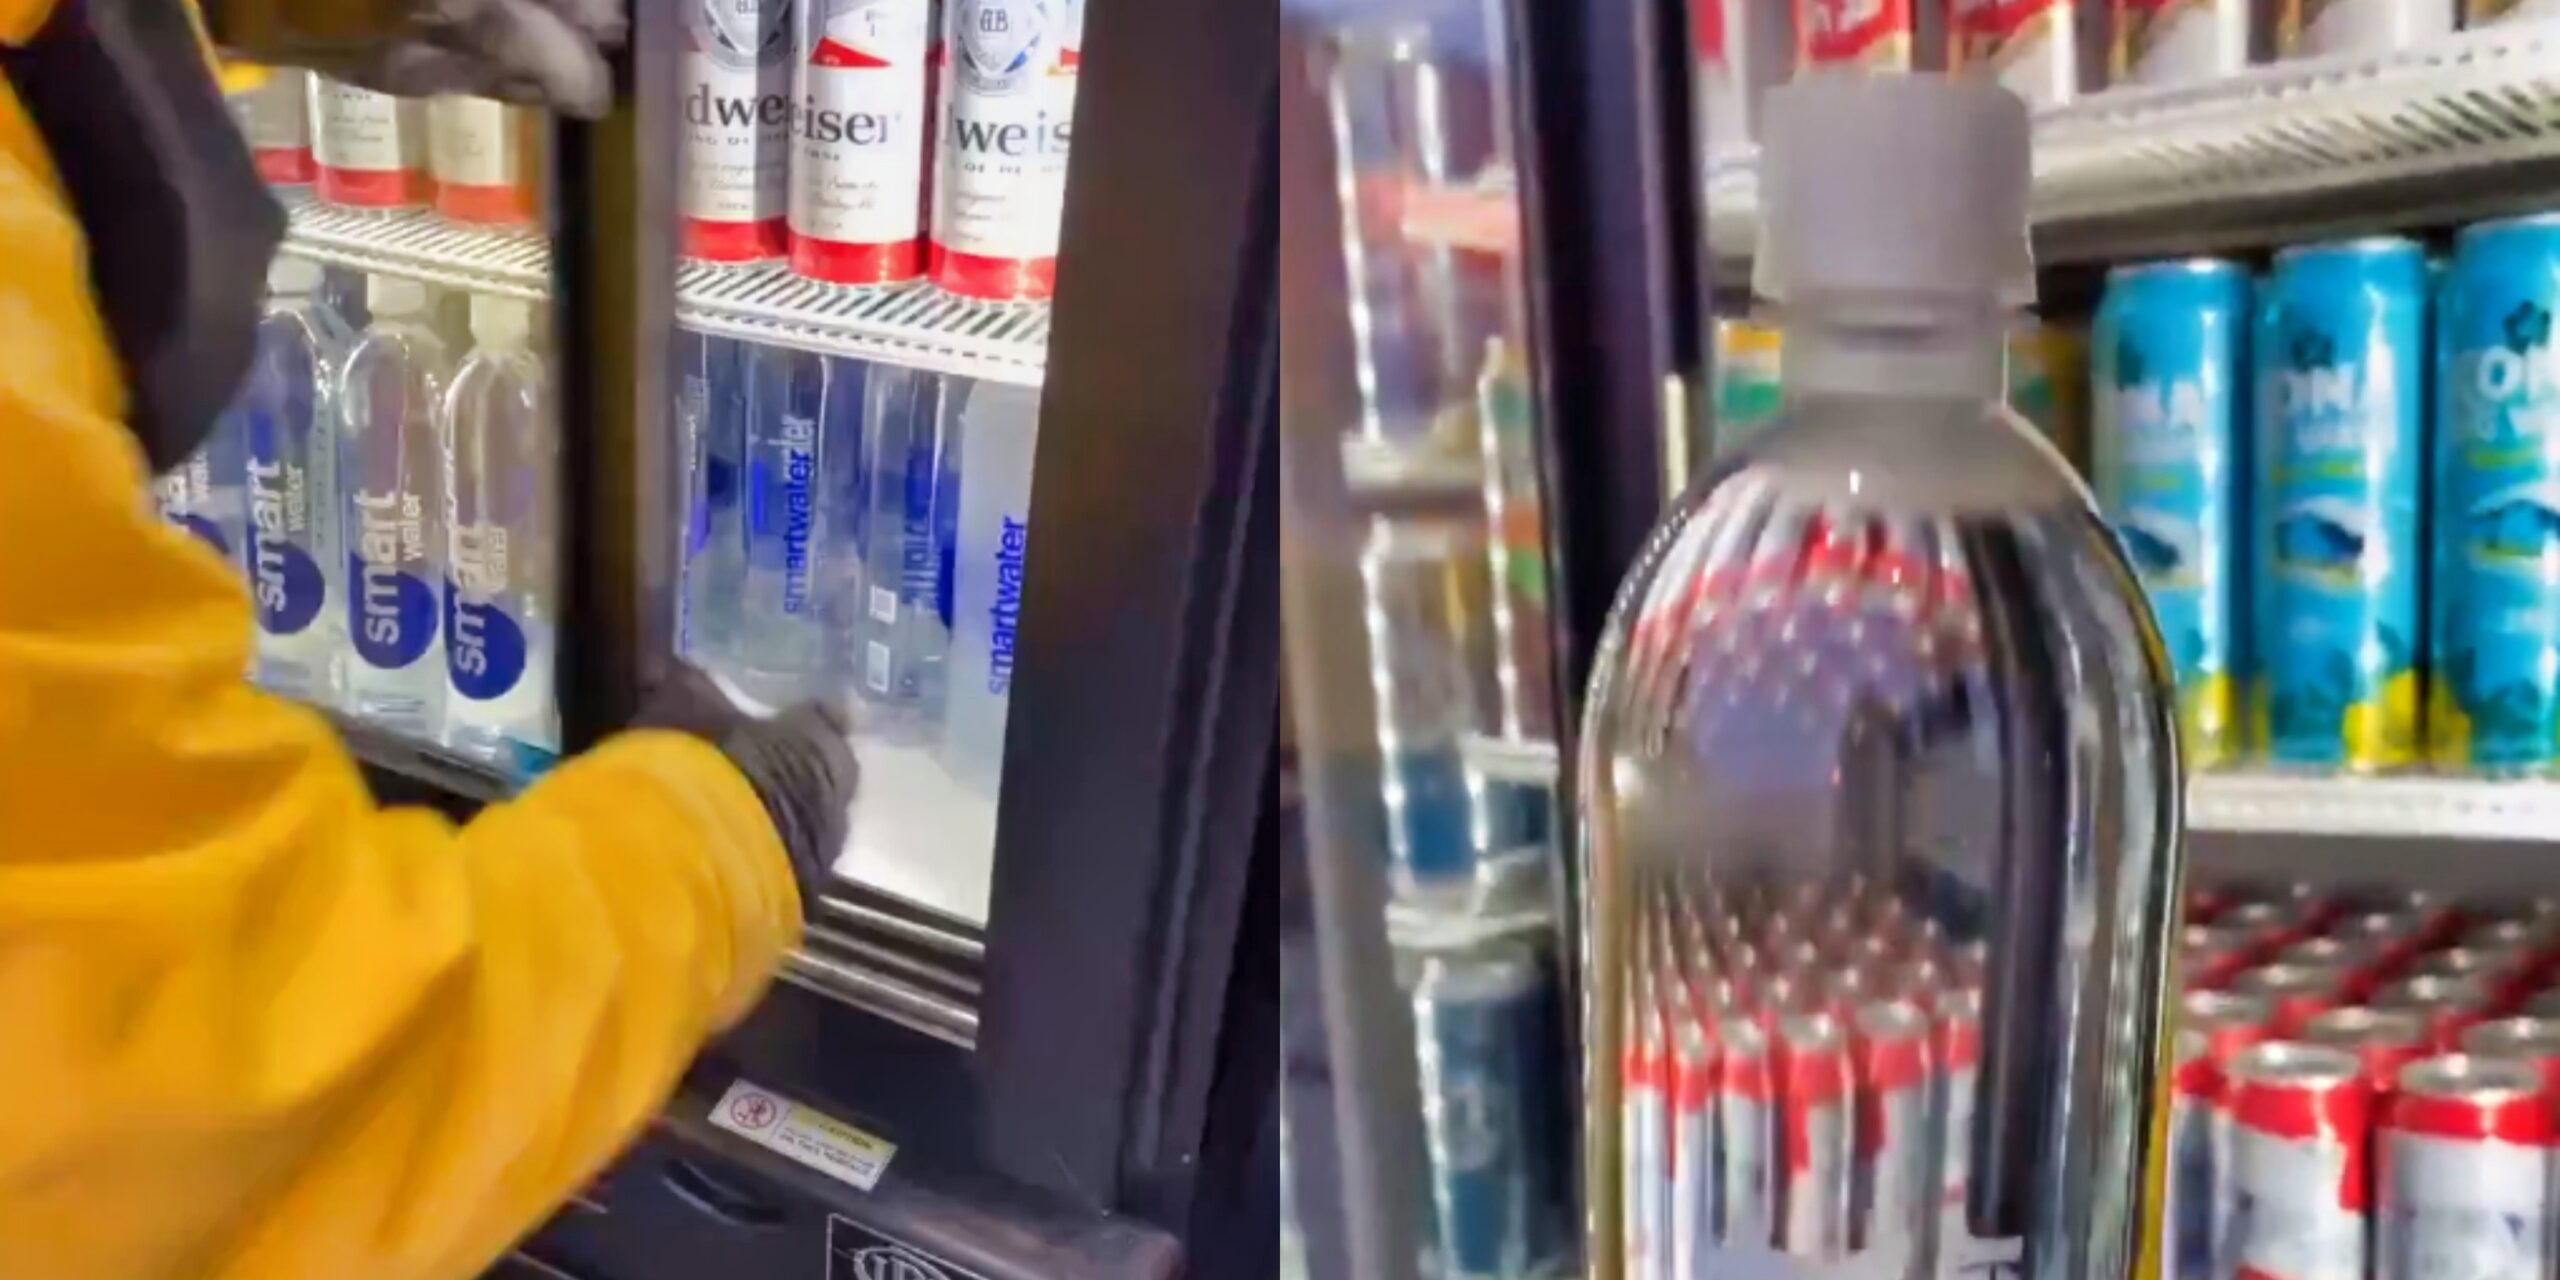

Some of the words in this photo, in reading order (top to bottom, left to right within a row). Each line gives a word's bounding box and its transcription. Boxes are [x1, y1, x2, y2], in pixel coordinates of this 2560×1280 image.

[246, 455, 287, 613] smart
[353, 487, 399, 646] smart
[402, 490, 425, 563] water
[783, 448, 813, 615] smartwater
[987, 514, 1027, 695] smartwater
